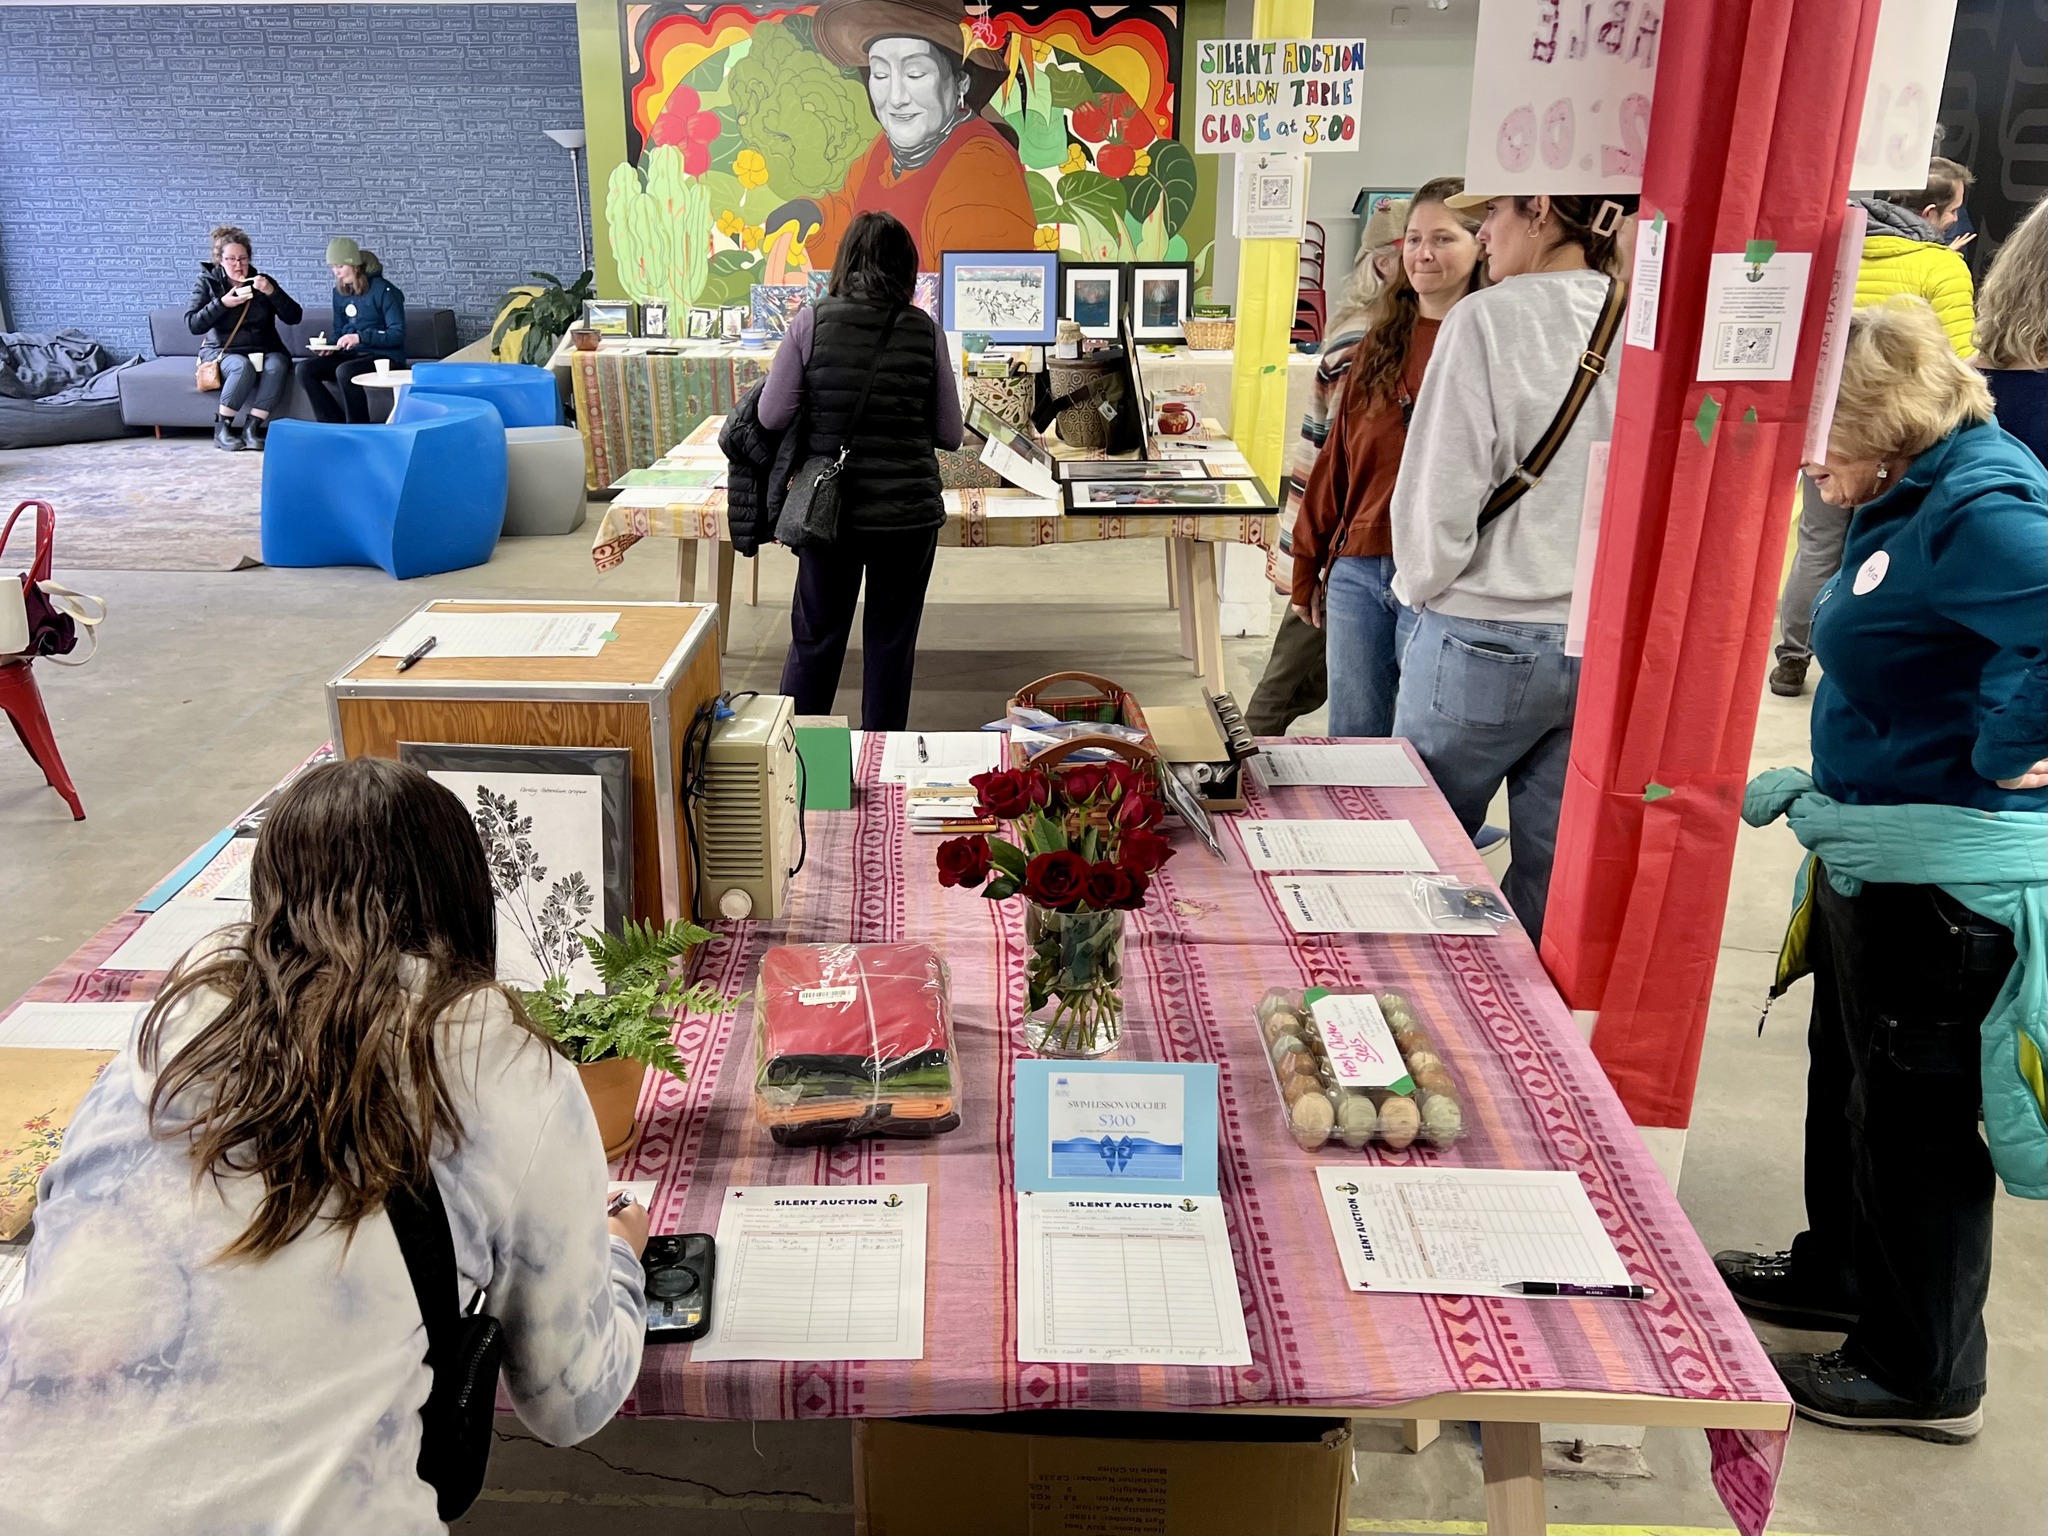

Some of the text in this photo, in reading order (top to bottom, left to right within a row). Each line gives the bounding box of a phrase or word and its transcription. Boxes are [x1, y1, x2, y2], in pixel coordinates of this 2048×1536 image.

[1201, 42, 1364, 74] SILENT AUCTION
[1207, 79, 1353, 107] YELLOW TABLE
[1202, 113, 1355, 144] CLOSE at 3:00
[1722, 325, 1733, 363] SCAN ME
[1334, 1052, 1360, 1079] Fresh
[1068, 1101, 1167, 1110] SWIM LESSON VOUCHER
[1350, 1198, 1375, 1261] SILENT AUCTION
